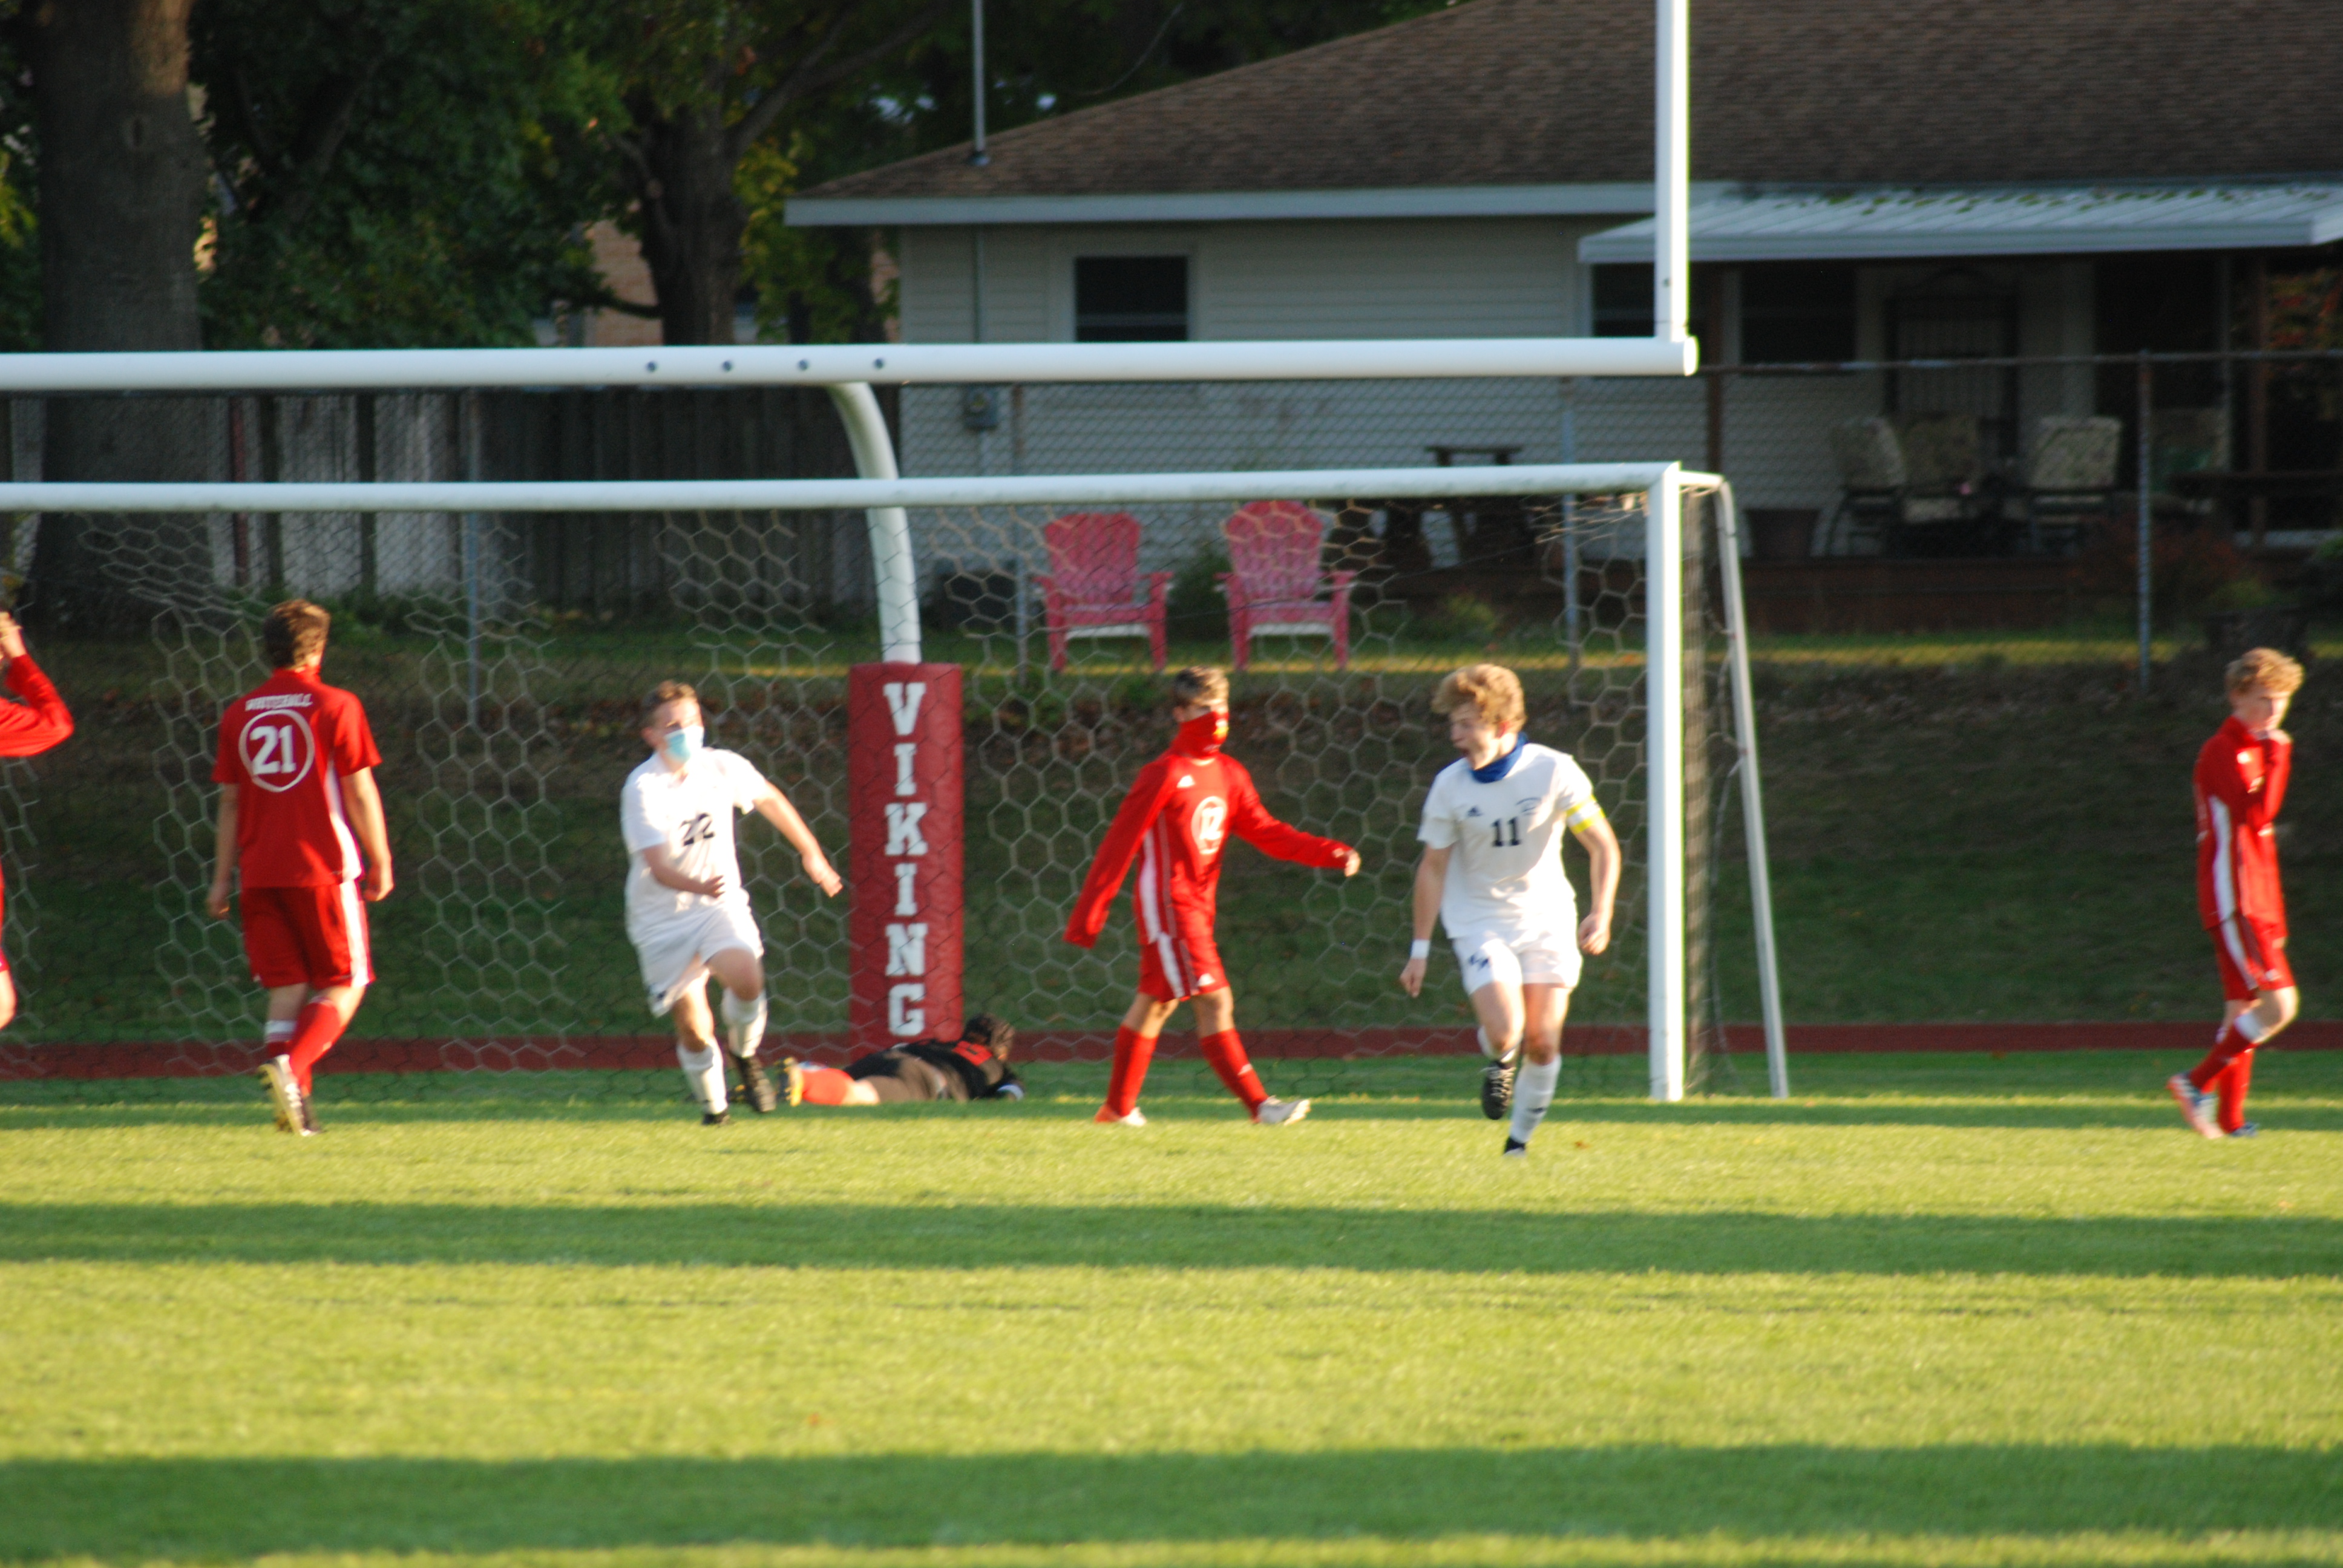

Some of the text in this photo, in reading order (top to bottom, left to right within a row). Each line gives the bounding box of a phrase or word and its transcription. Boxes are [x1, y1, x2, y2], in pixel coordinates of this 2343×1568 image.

[249, 724, 297, 775] 21
[679, 812, 716, 847] 22
[1491, 817, 1522, 848] 11
[883, 682, 928, 1036] VIKING
